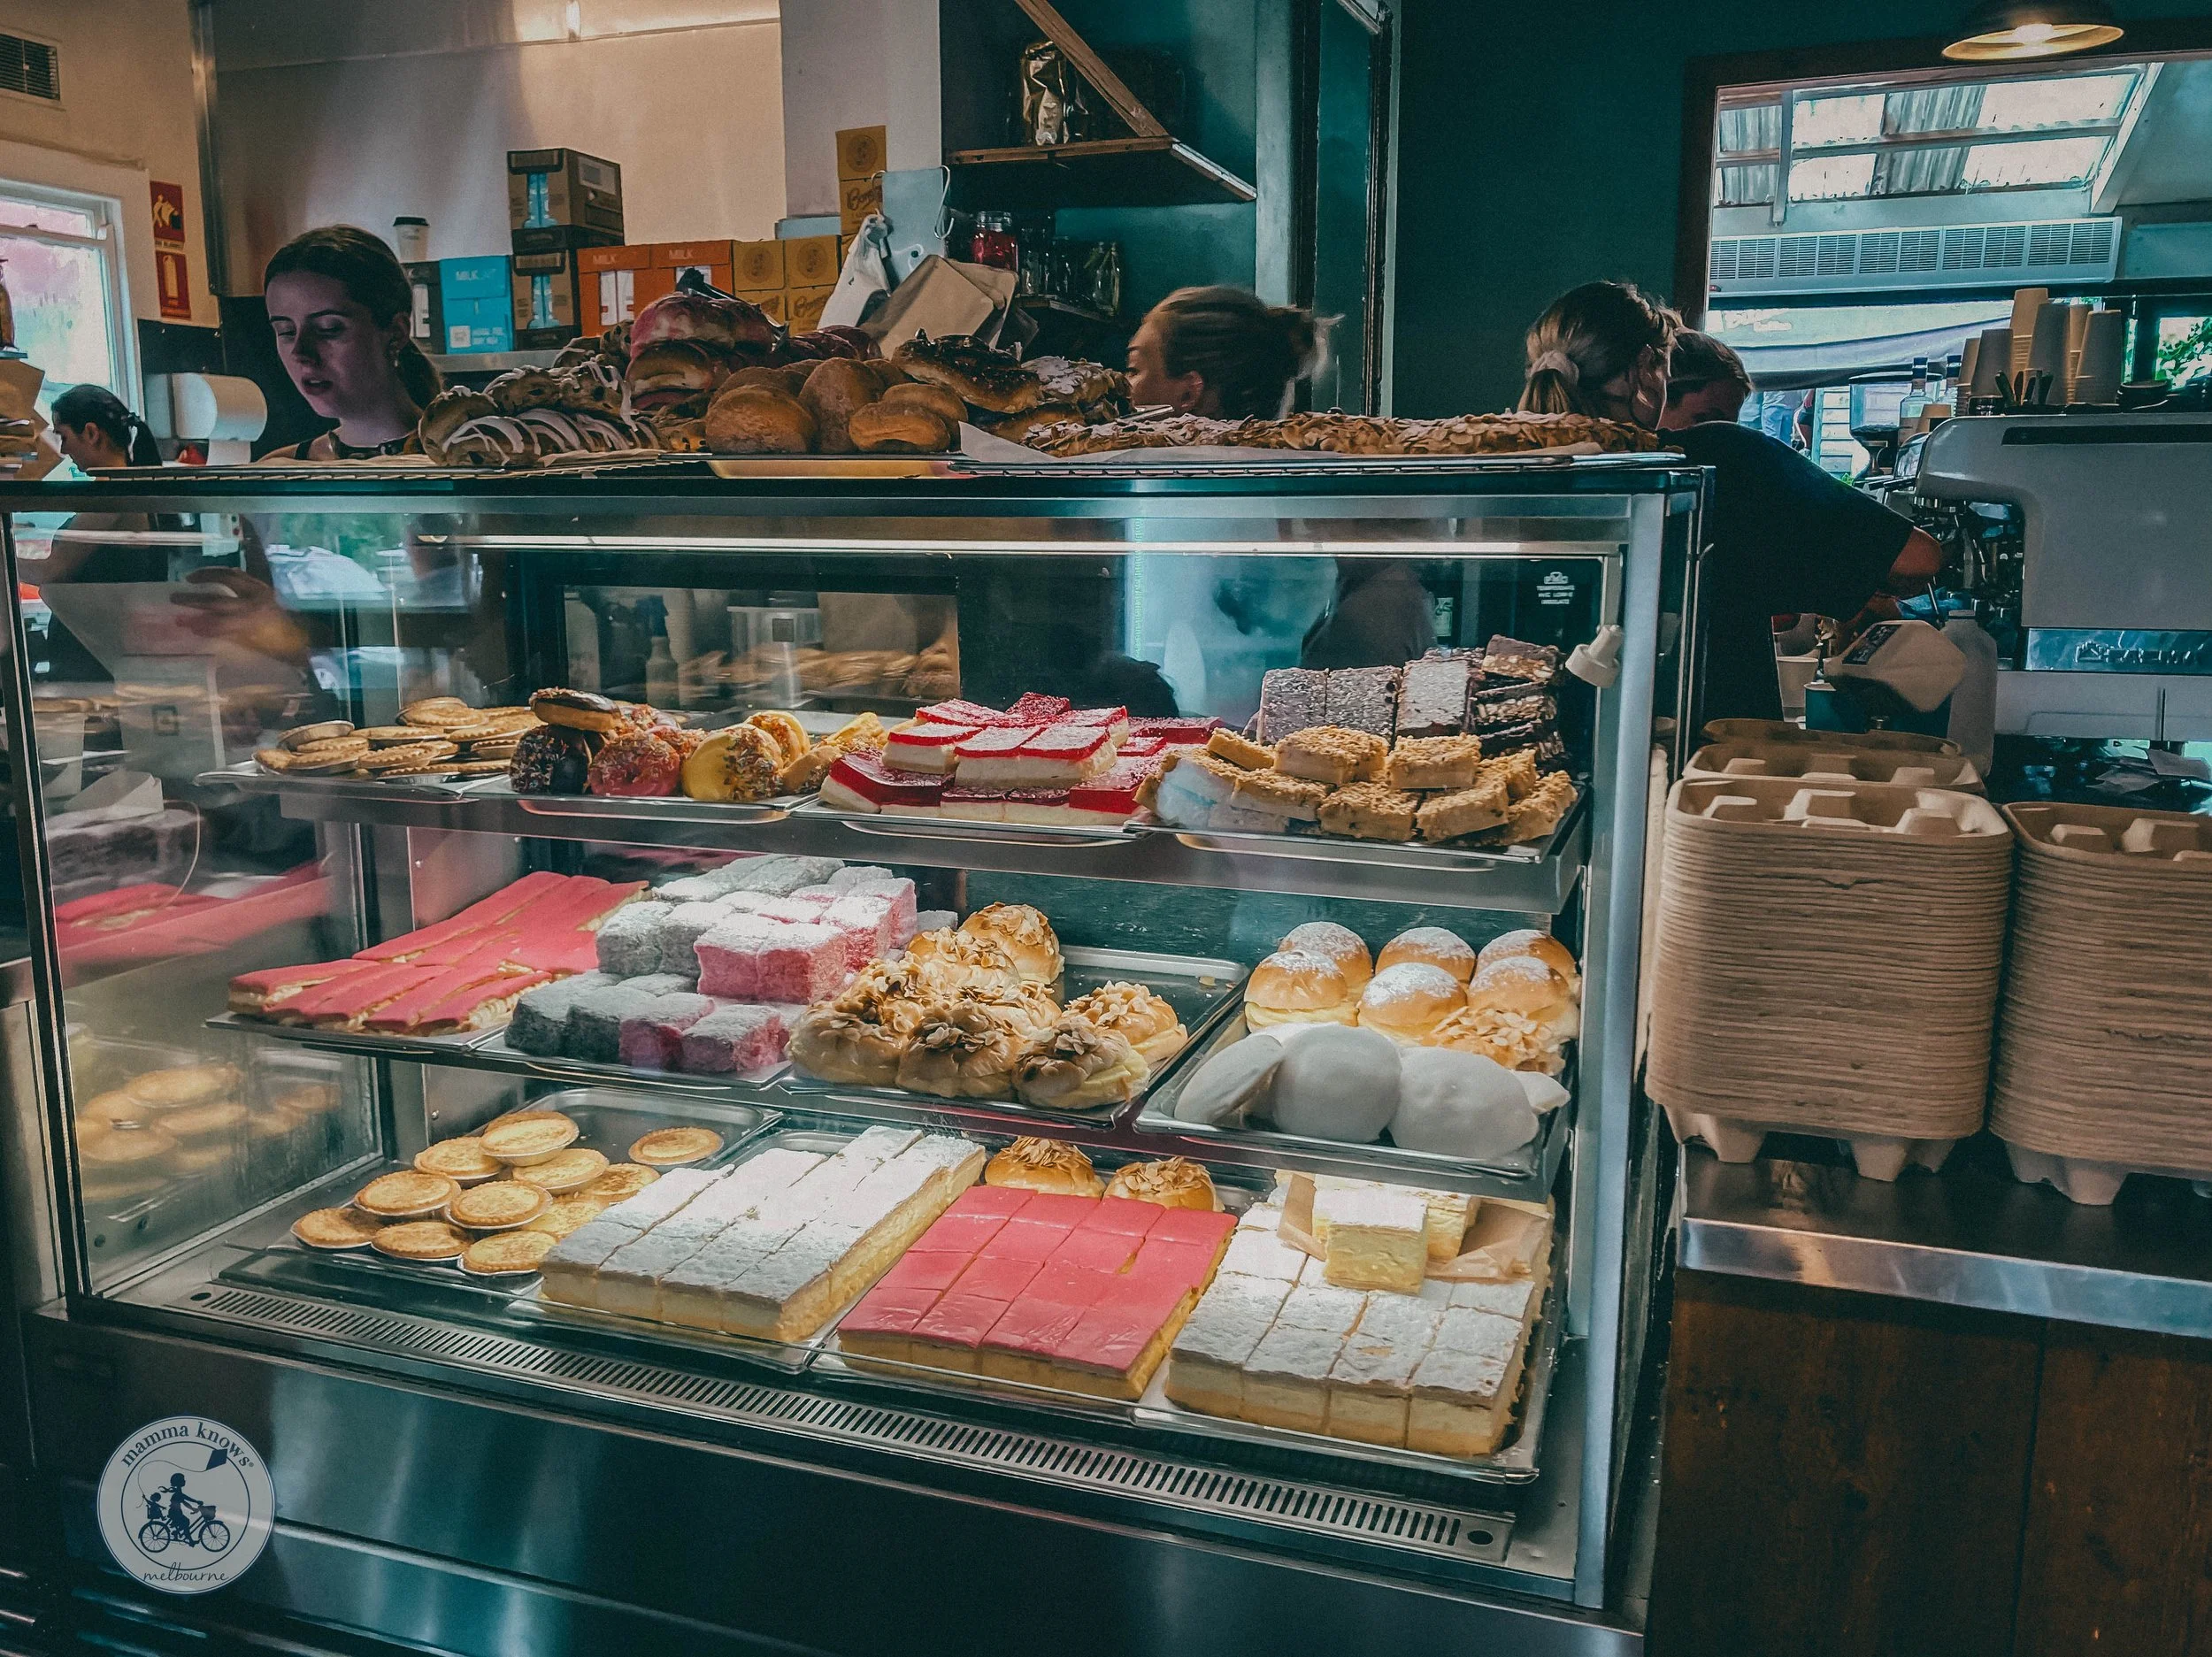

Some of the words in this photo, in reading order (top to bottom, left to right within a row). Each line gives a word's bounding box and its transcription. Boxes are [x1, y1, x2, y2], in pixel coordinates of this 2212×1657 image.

[592, 254, 617, 265] MILK
[669, 249, 694, 260] MILK
[456, 269, 479, 280] MILK
